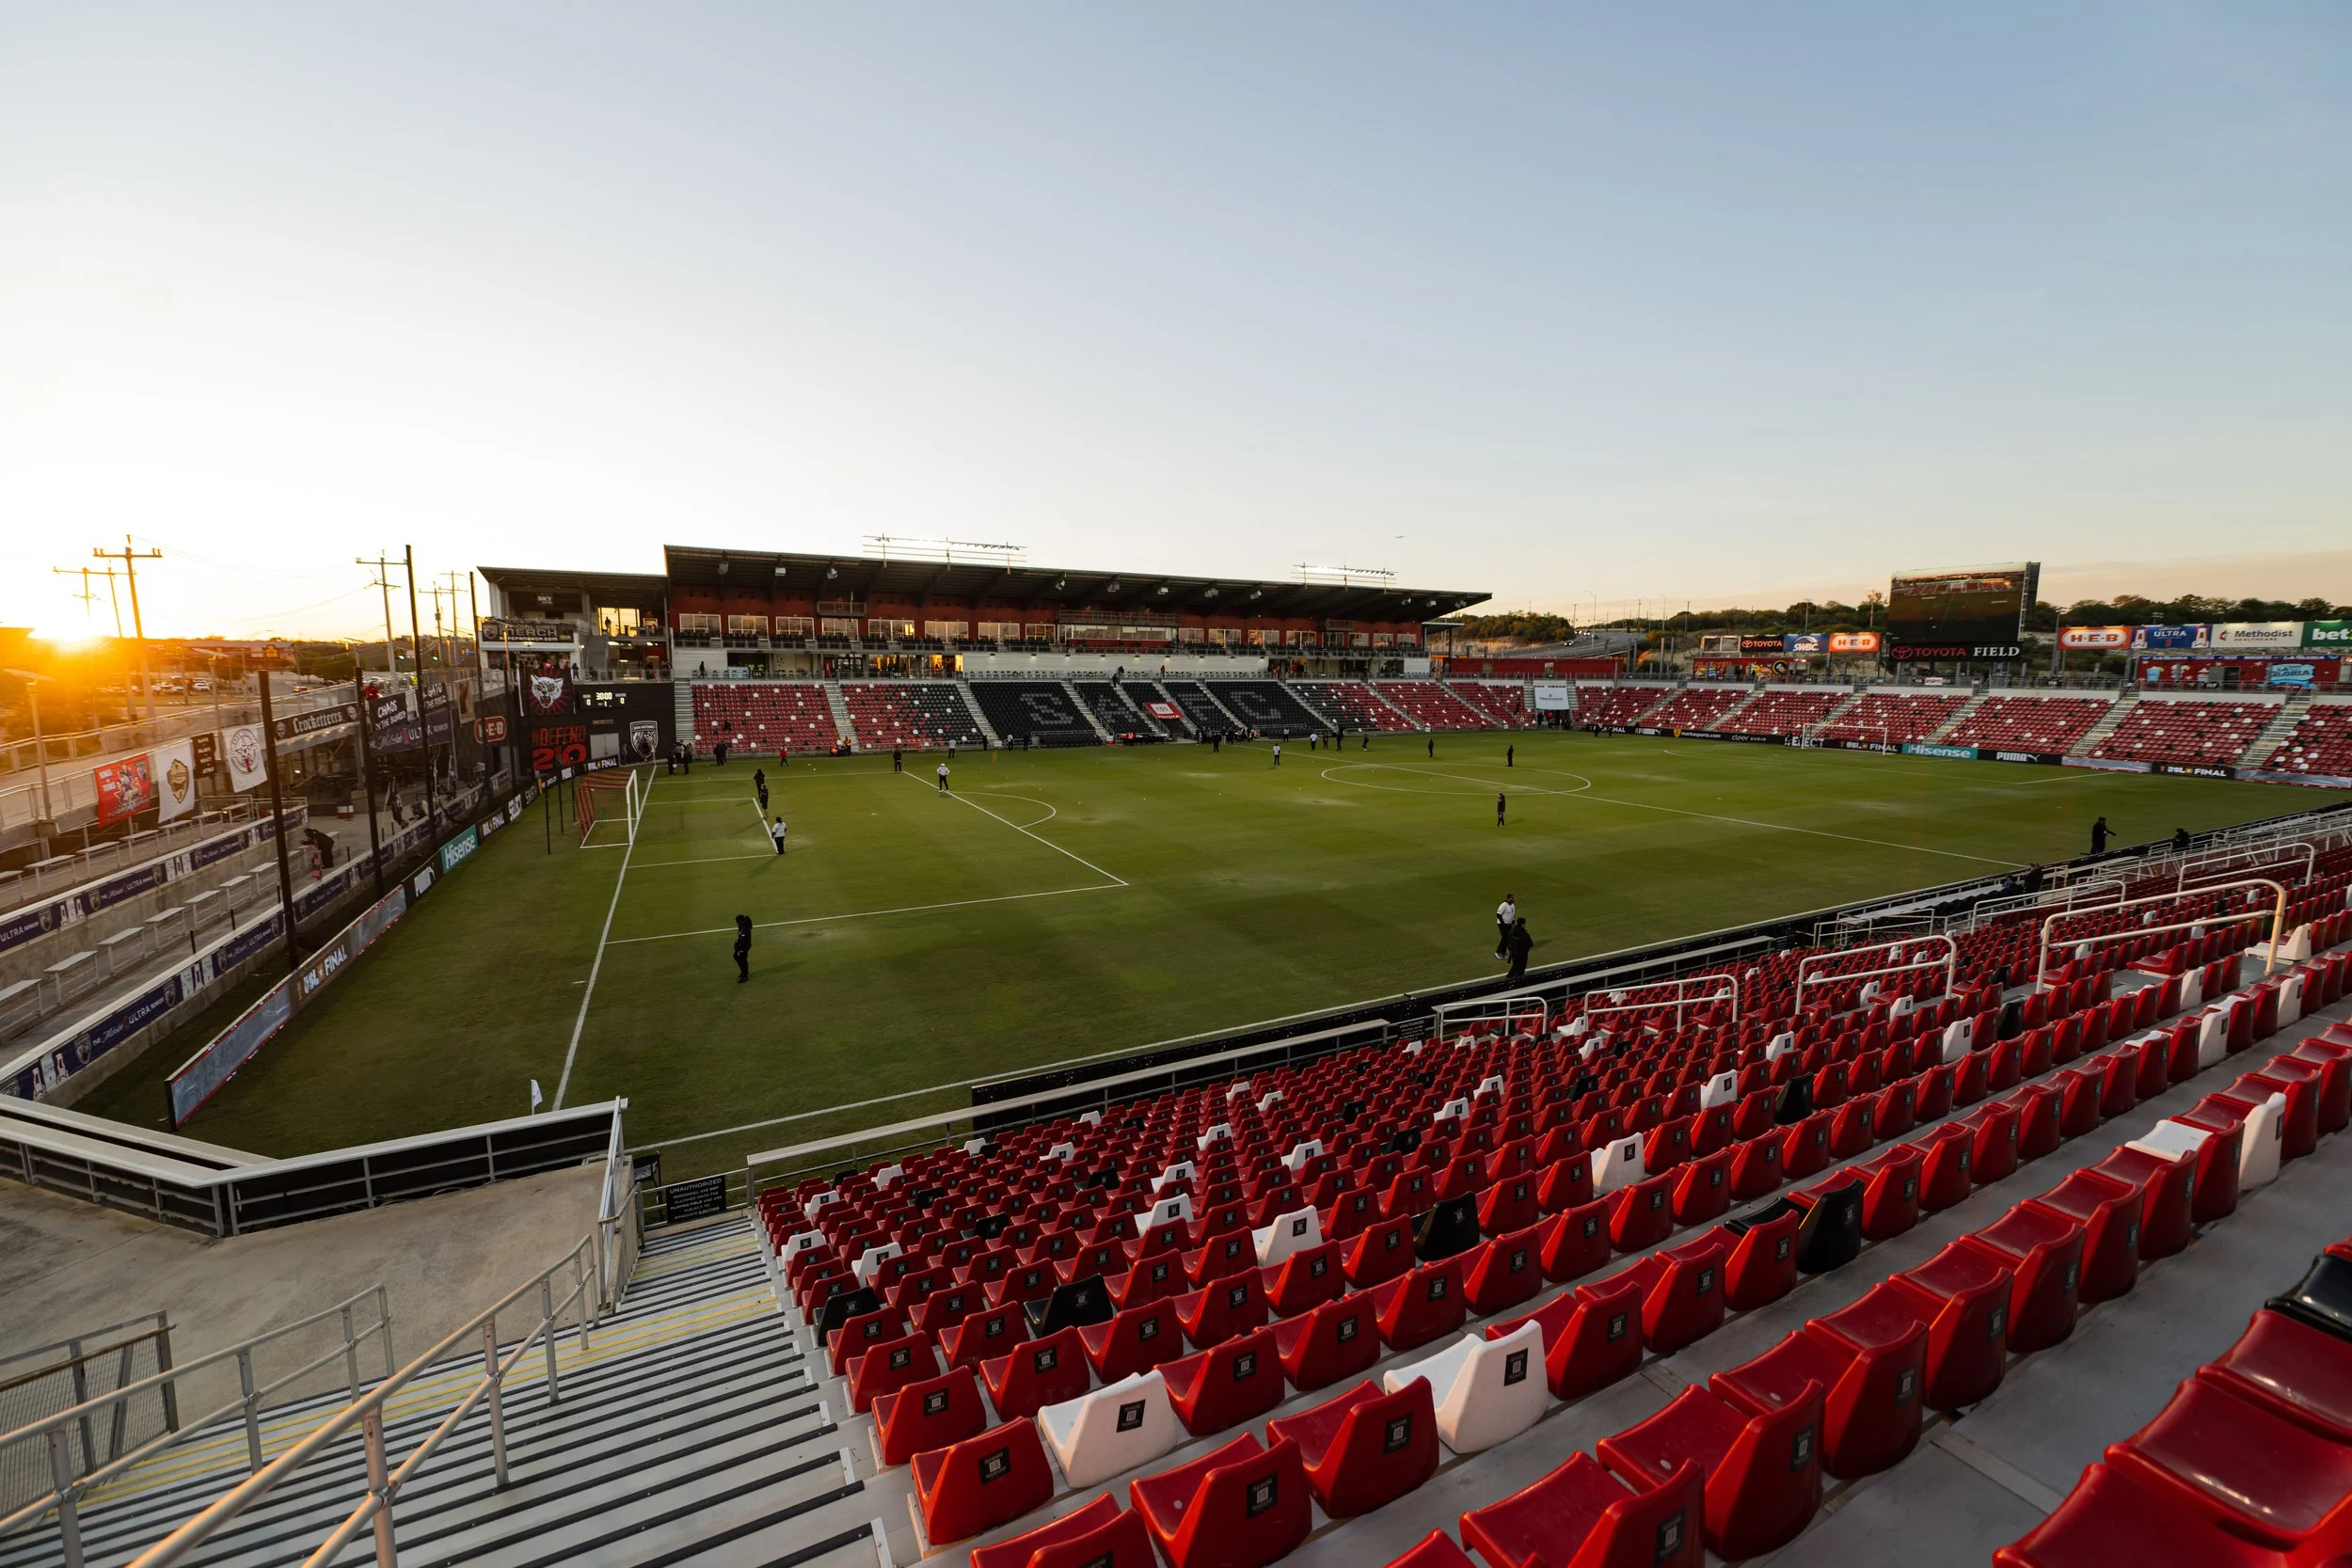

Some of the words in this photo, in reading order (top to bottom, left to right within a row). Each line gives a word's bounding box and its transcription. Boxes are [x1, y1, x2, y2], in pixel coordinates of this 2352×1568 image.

[1793, 642, 1819, 652] SWBC
[1915, 647, 1966, 657] TOYOTA
[1973, 646, 2020, 657] FIELD
[377, 700, 398, 719] CHAOS
[293, 711, 342, 734] Crocketteers
[408, 725, 434, 741] ULTA
[1868, 743, 1898, 752] FINAL
[1908, 744, 1971, 758] Hisense
[602, 757, 617, 768] FINAL
[1996, 752, 2027, 762] PUMA
[2194, 768, 2227, 777] FINAL
[444, 834, 475, 869] Hisense
[0, 927, 24, 942] ULTRA
[303, 969, 320, 993] USL
[324, 944, 348, 976] FINAL
[128, 1006, 151, 1024] ULTRA
[670, 1179, 722, 1194] UNAUTHORIZED
